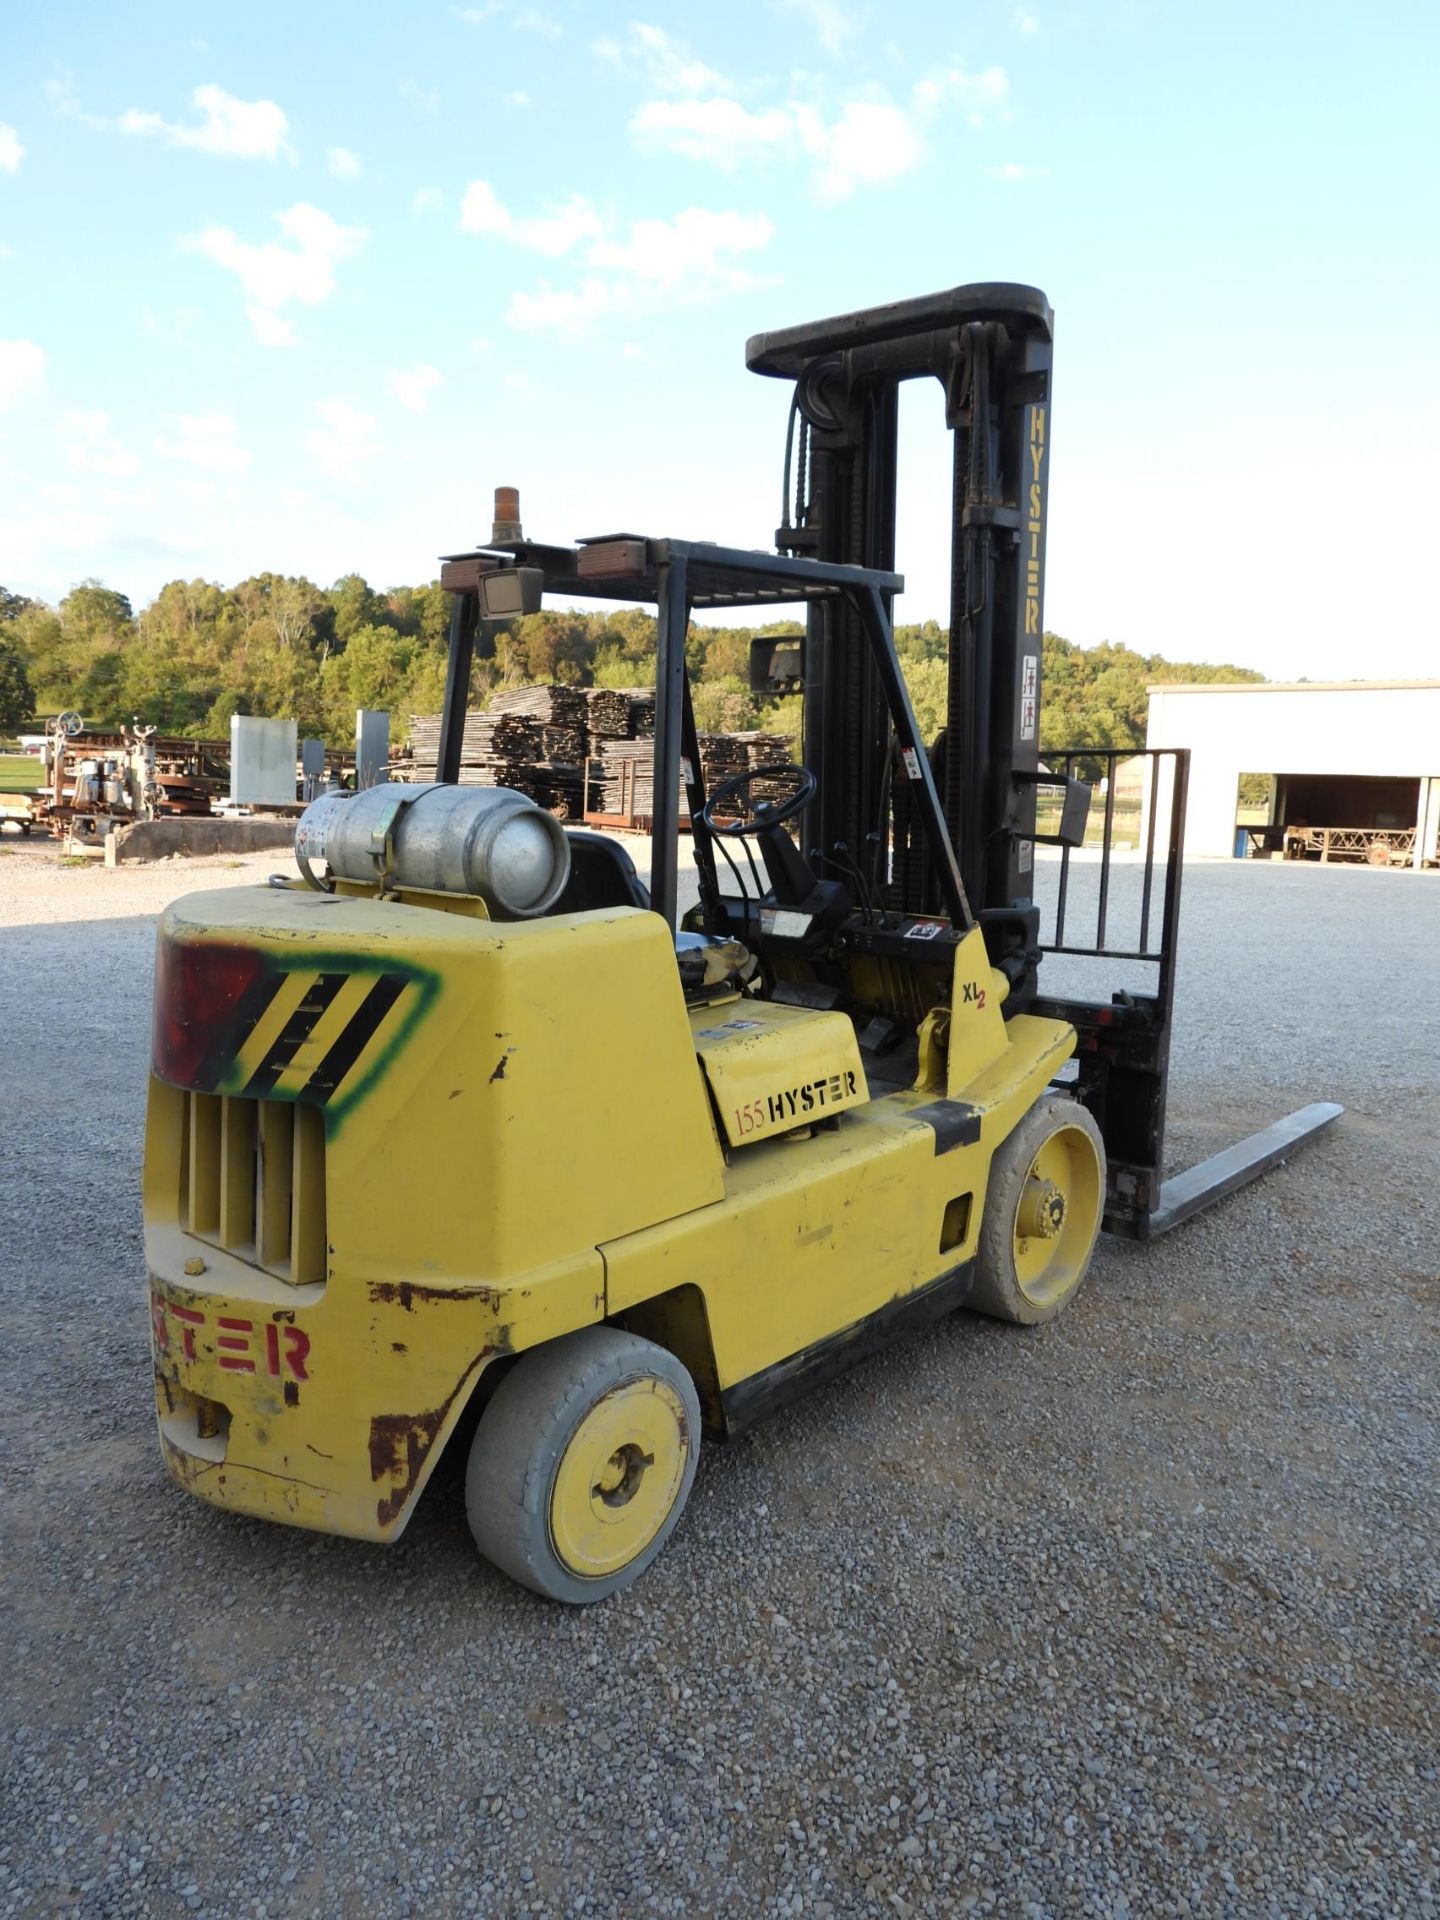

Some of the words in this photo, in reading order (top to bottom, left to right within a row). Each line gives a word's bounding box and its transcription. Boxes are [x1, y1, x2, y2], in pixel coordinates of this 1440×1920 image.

[1025, 406, 1045, 634] HYSTER
[735, 1099, 765, 1136] 155
[767, 1071, 857, 1122] HYSTER
